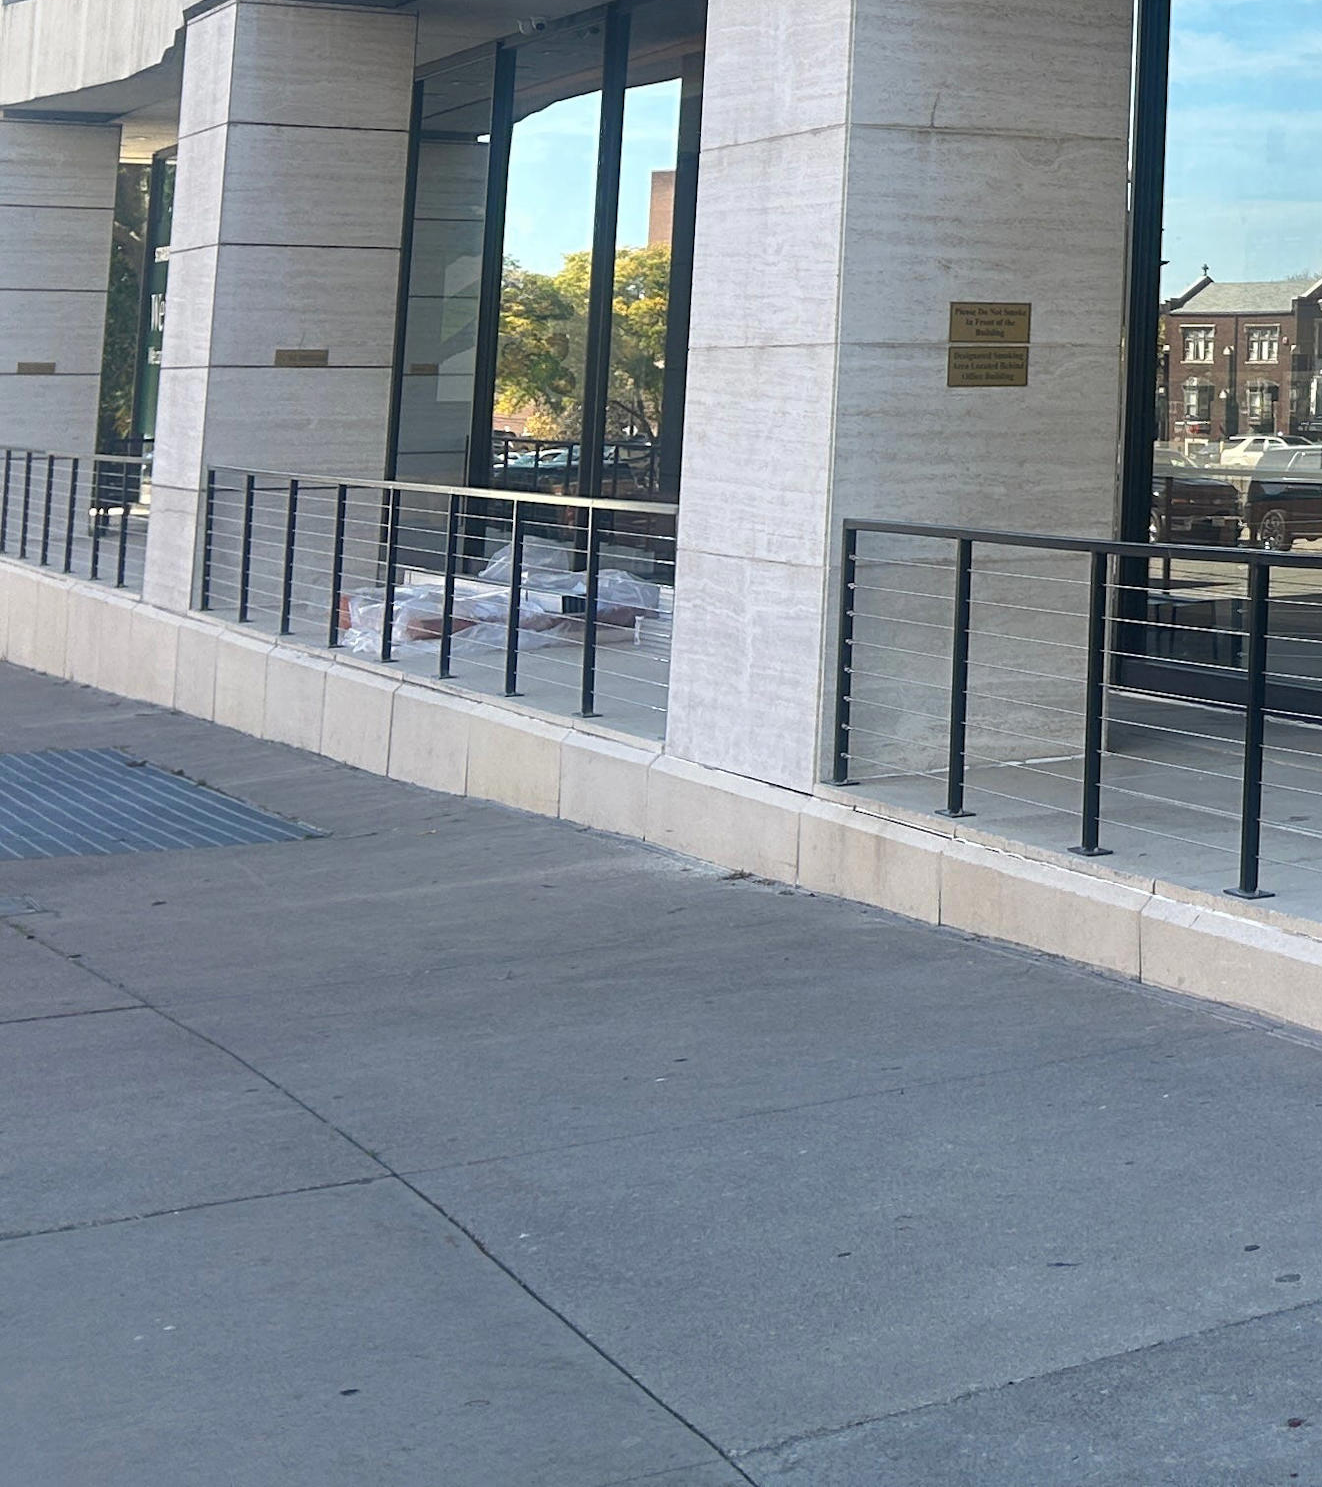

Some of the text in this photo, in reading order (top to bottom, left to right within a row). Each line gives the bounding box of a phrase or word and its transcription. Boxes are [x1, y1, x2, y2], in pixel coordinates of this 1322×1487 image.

[955, 308, 1026, 316] Please Do Not Smoke
